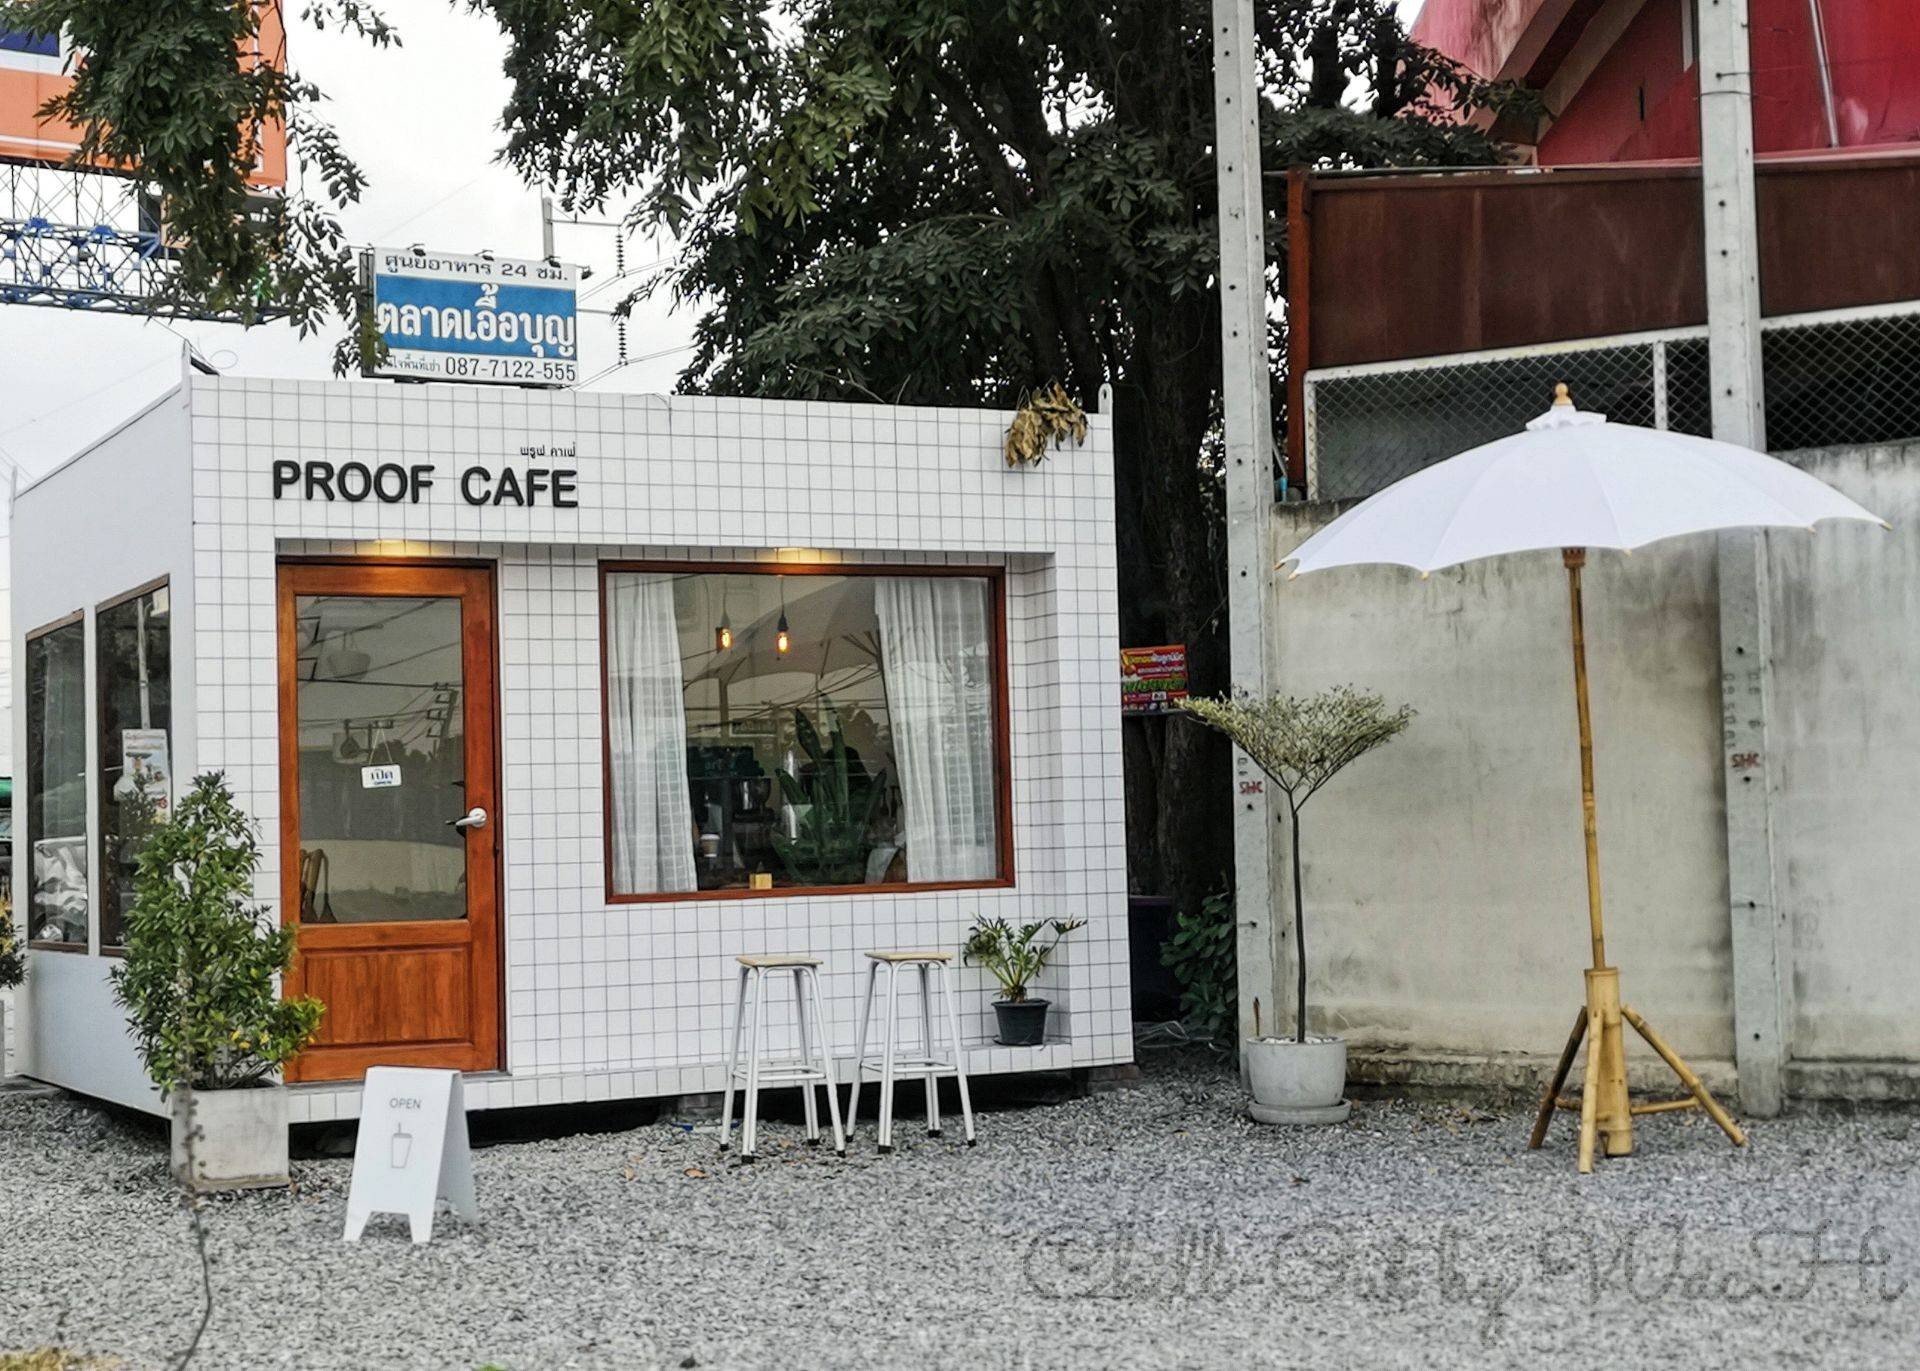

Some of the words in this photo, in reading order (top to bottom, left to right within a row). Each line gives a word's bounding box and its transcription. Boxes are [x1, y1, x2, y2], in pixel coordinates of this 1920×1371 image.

[385, 255, 492, 275] ศูนยอาหาร
[501, 263, 528, 277] 24
[537, 268, 568, 281] ชม.
[377, 283, 575, 358] ตลาดเอื้อบุญ
[445, 357, 577, 382] 087-7122-555
[551, 441, 576, 457] คาเฟ่
[272, 460, 435, 504] PROOF
[461, 466, 579, 508] CAFE
[389, 1098, 422, 1109] OPEN
